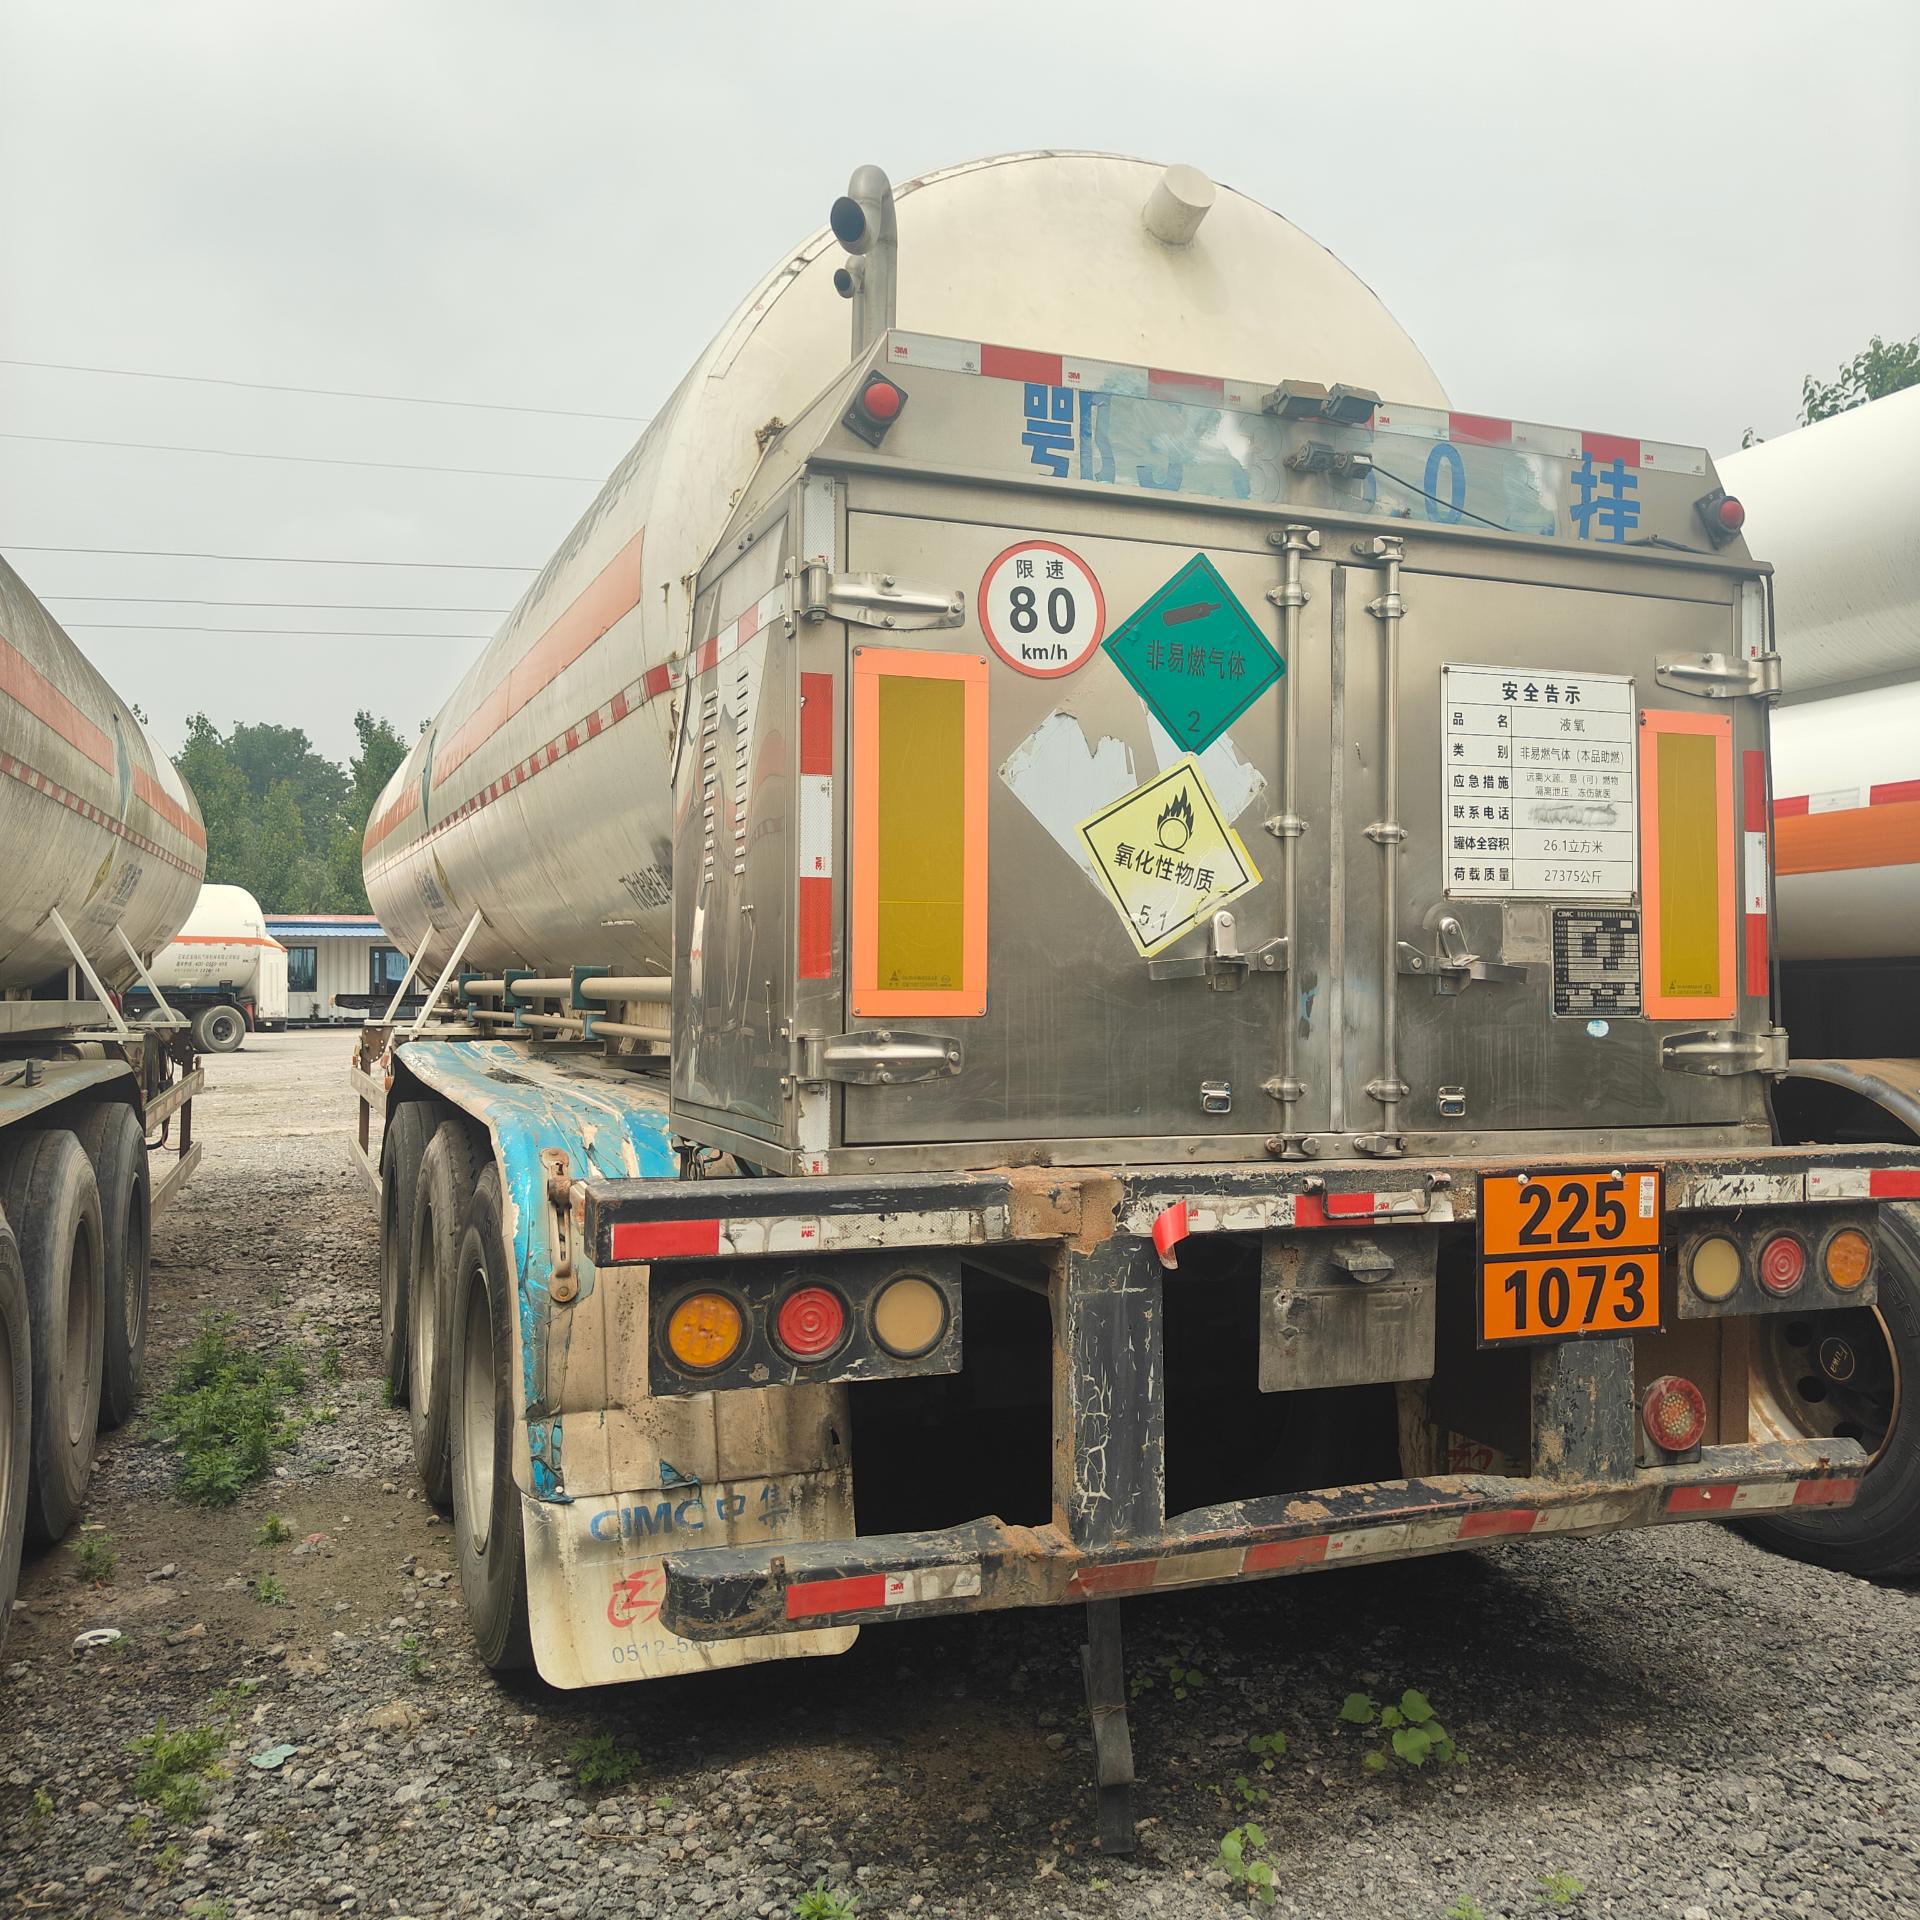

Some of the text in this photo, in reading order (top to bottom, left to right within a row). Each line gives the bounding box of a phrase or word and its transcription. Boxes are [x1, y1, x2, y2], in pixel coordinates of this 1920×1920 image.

[895, 346, 908, 354] 3M
[1068, 371, 1080, 380] 3M
[1379, 416, 1390, 424] 3M
[1644, 454, 1654, 462] 3M
[1016, 559, 1065, 580] 限速
[1009, 586, 1076, 635] 80
[1021, 643, 1068, 661] km/h
[1146, 640, 1246, 681] 非易燃气体
[1502, 681, 1581, 705] 安全告示
[1188, 710, 1201, 733] 2
[1452, 712, 1586, 733] 品名 液氧
[1453, 743, 1509, 760] 类别
[1453, 774, 1510, 790] 应急措施
[1453, 805, 1510, 821] 联系电话
[1453, 835, 1604, 854] 罐体全容积 26.1立方米
[815, 856, 823, 870] 3M
[1113, 842, 1215, 893] 氧化性物质
[1454, 866, 1603, 885] 荷载质量 27375公斤
[1138, 904, 1168, 931] 5.1
[1518, 1181, 1627, 1246] 225
[1504, 1262, 1645, 1330] 1073
[589, 1500, 705, 1542] CIMC
[890, 1583, 904, 1592] 3M
